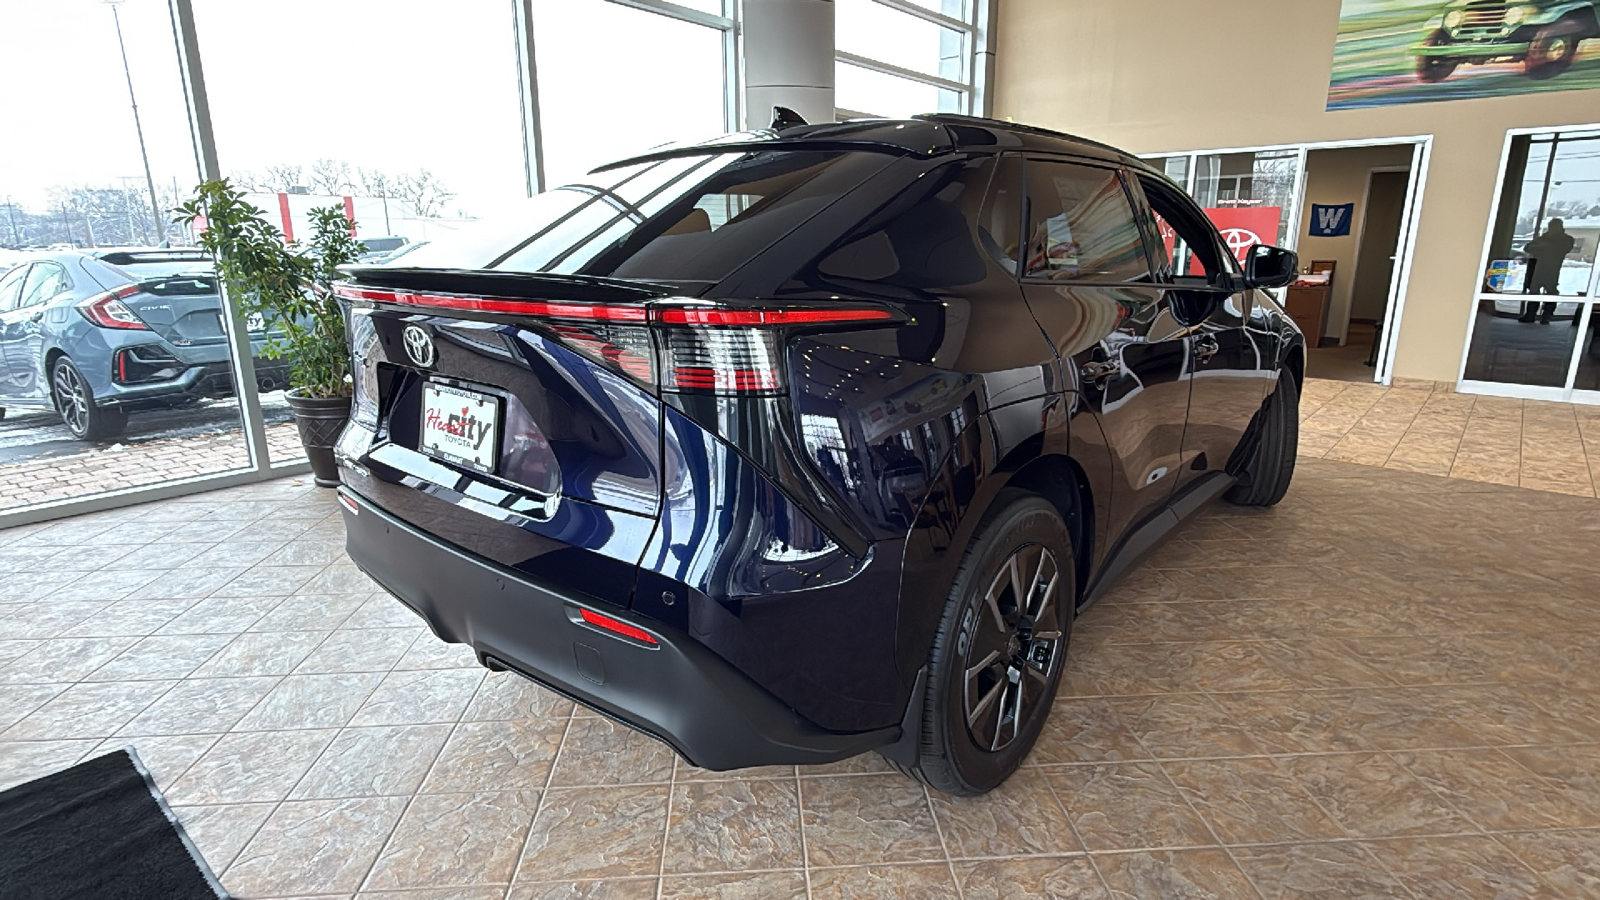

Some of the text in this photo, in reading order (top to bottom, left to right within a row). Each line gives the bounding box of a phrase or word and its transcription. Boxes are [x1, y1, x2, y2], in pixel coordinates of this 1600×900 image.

[1318, 207, 1346, 229] W
[426, 407, 472, 437] Heart
[444, 434, 472, 449] TOYOTA
